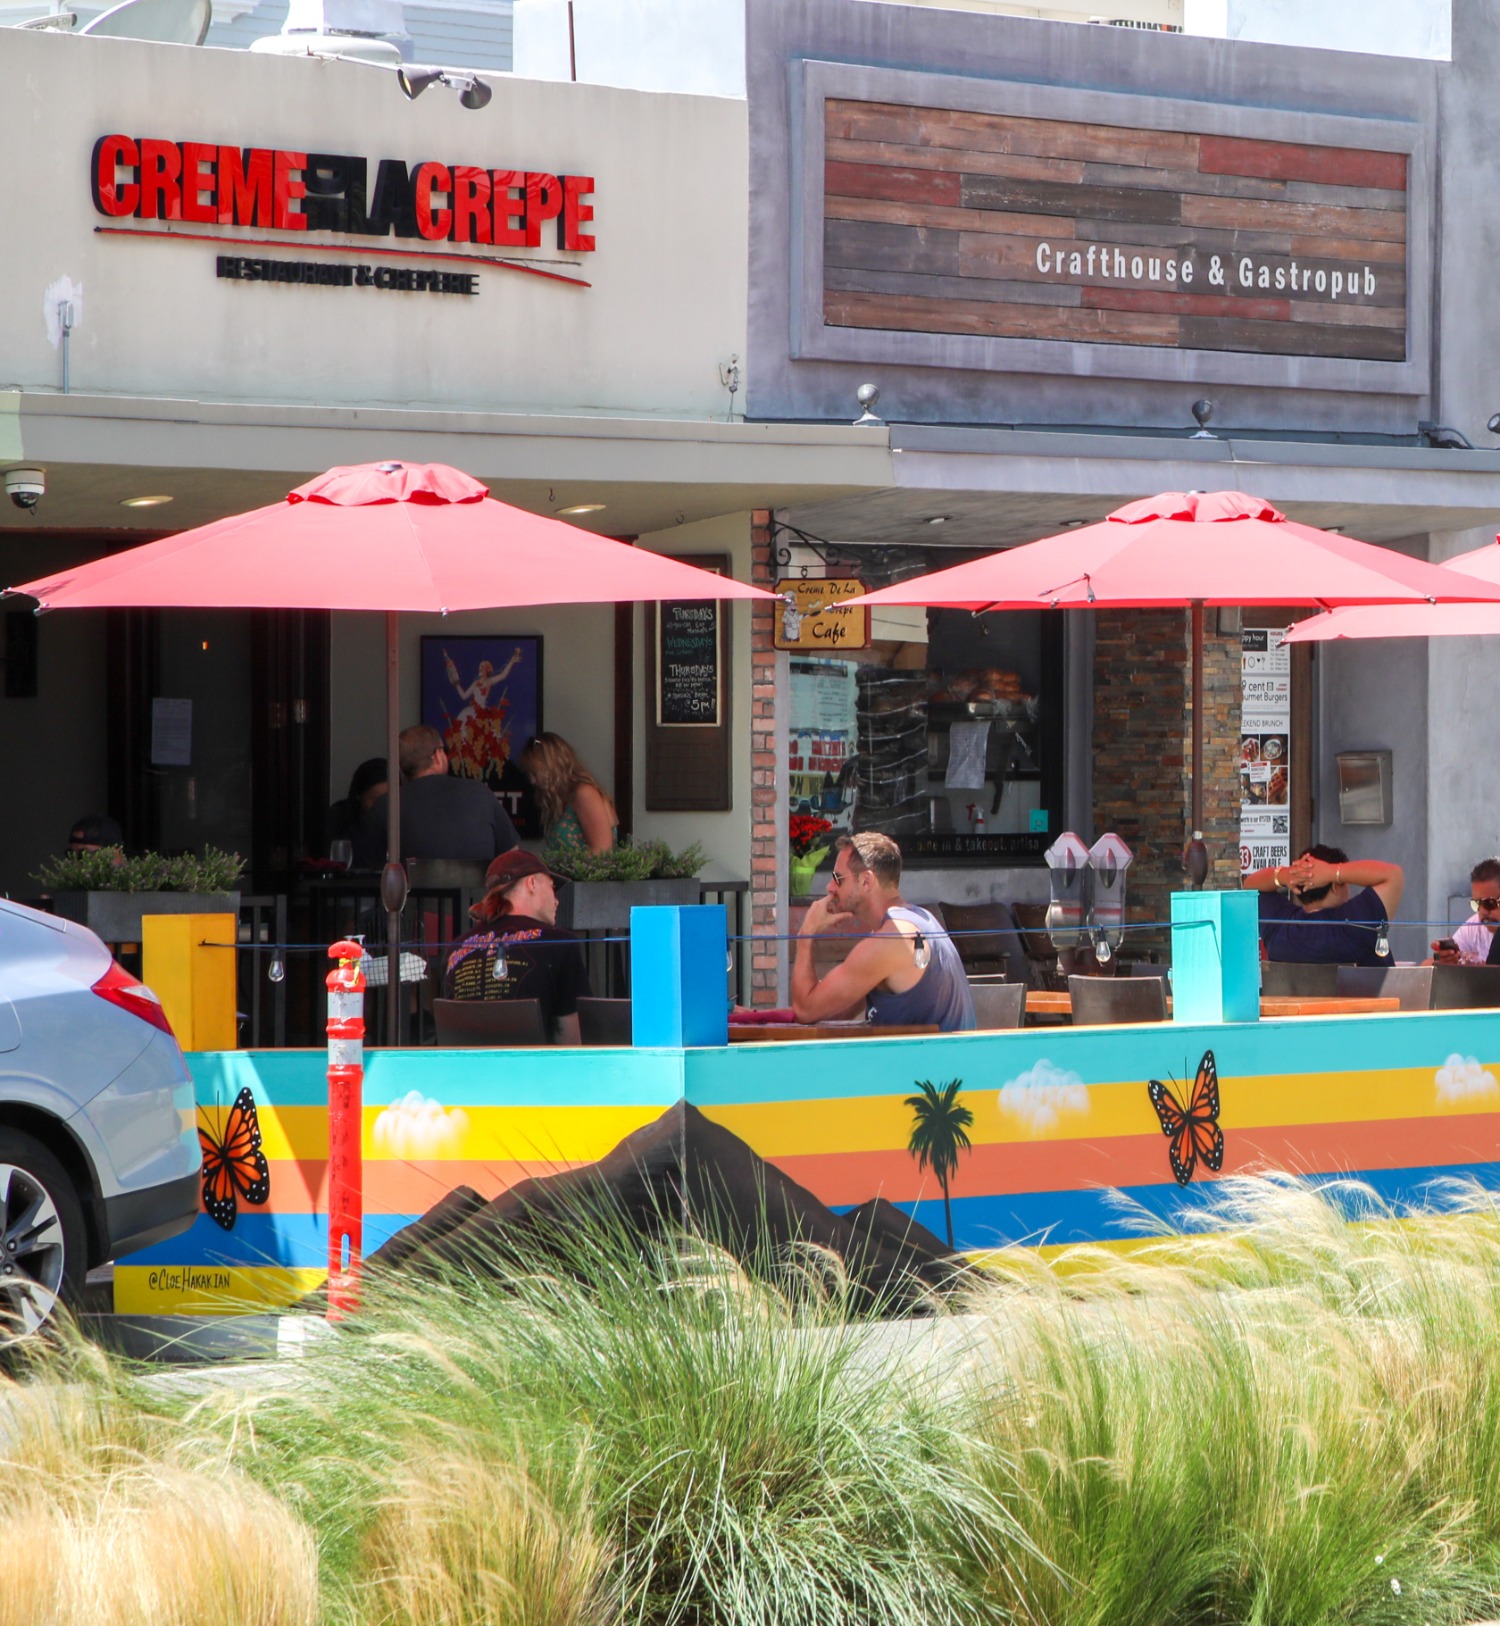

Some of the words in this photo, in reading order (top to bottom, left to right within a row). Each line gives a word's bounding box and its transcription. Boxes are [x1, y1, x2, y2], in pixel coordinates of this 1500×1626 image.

[91, 134, 307, 230] CREME
[409, 160, 596, 252] CREPE
[216, 256, 356, 287] RESTAURANT
[355, 264, 374, 286] &
[373, 267, 480, 295] CREPERIE
[1036, 242, 1194, 284] Crafthouse
[1208, 255, 1225, 286] &
[1238, 257, 1377, 300] Gastropub
[797, 582, 825, 595] Creme
[829, 582, 842, 594] De
[844, 582, 856, 594] La
[812, 621, 847, 645] Cafe
[668, 664, 714, 677] THURSDAYS
[1248, 681, 1266, 692] cent
[1244, 692, 1263, 701] urmet
[1264, 692, 1288, 703] Burgers
[1252, 846, 1270, 857] CRAFT
[1271, 846, 1287, 857] BEERS
